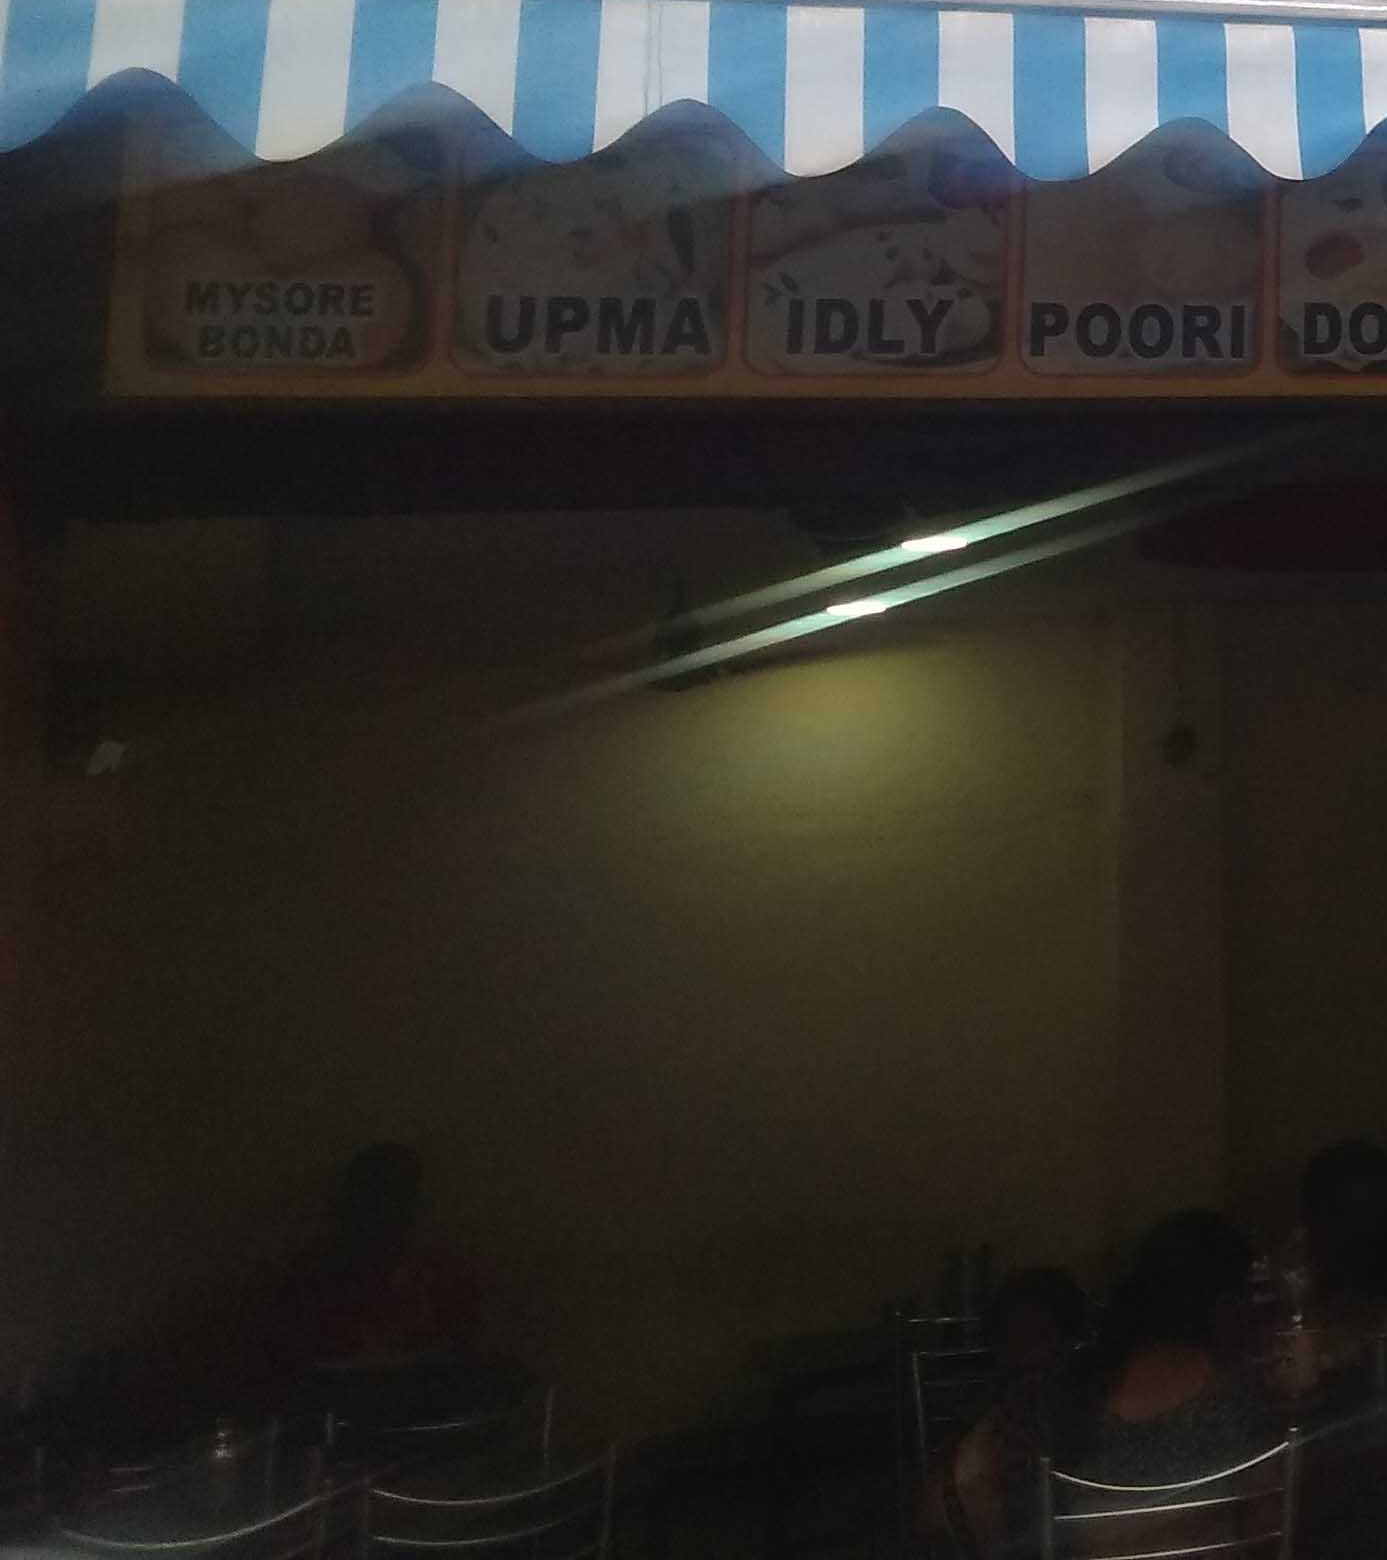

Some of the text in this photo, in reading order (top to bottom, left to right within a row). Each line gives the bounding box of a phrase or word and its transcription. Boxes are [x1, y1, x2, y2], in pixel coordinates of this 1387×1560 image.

[184, 280, 375, 317] MYSORE
[485, 294, 713, 356] UPMA
[785, 298, 955, 356] IDLY
[200, 326, 356, 360] BONDA
[1029, 301, 1246, 359] POORI
